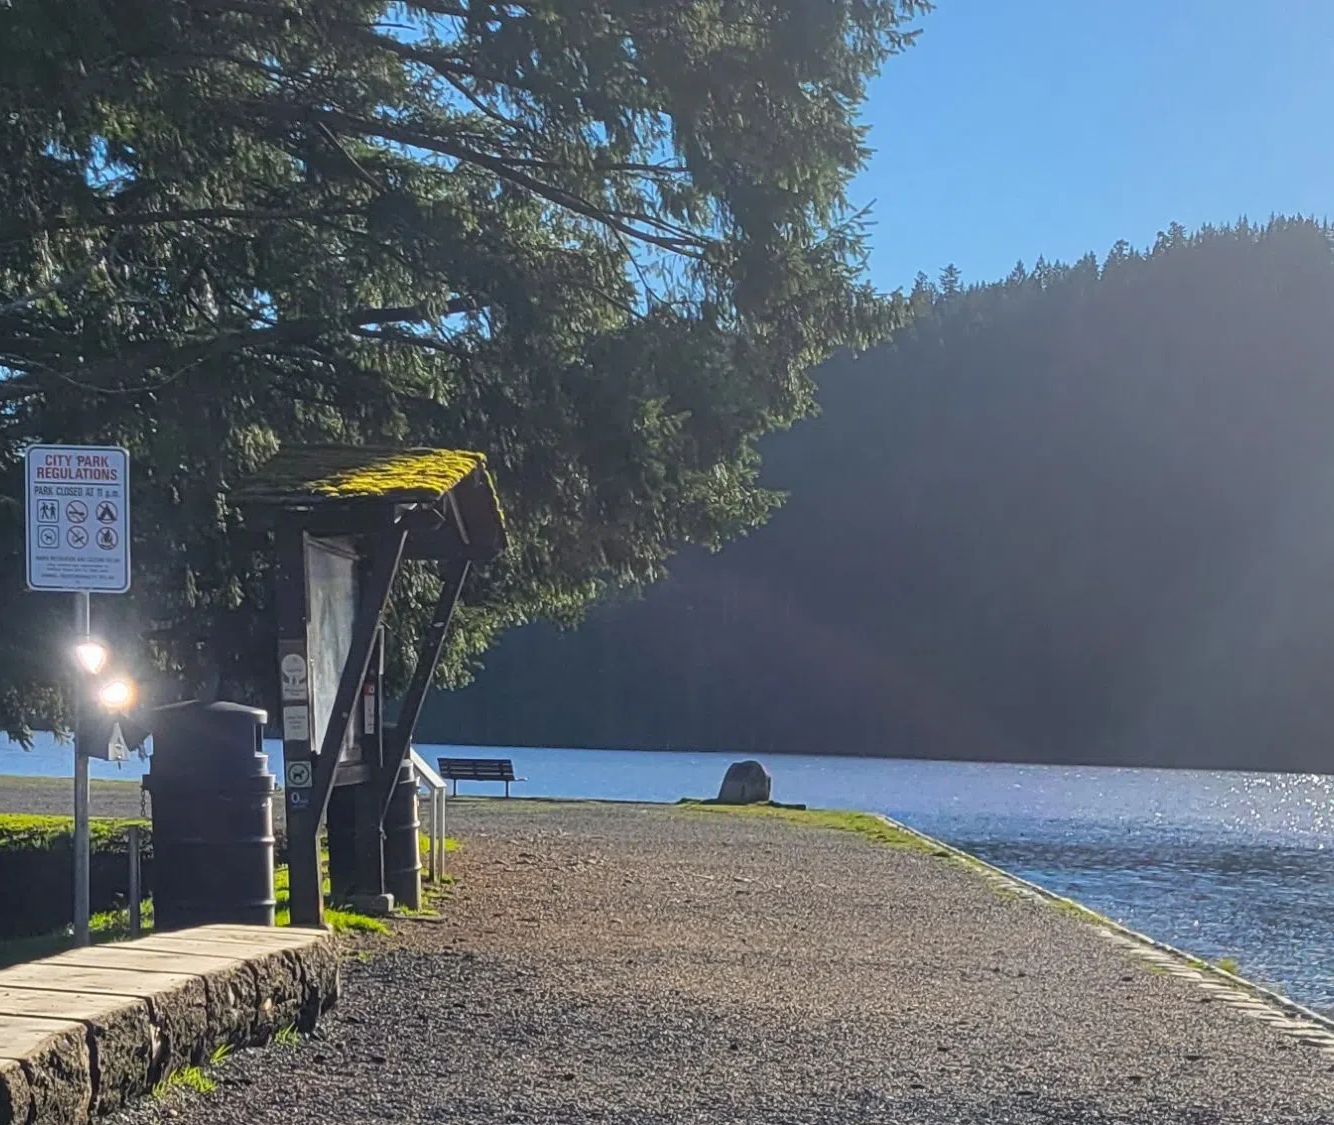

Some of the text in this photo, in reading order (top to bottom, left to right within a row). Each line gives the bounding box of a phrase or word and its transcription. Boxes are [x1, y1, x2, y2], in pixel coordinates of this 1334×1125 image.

[45, 454, 109, 467] CITY PARK
[36, 467, 117, 480] REGULATIONS
[34, 486, 53, 496] PARK
[56, 487, 83, 496] CLOSED
[85, 487, 94, 496] AT
